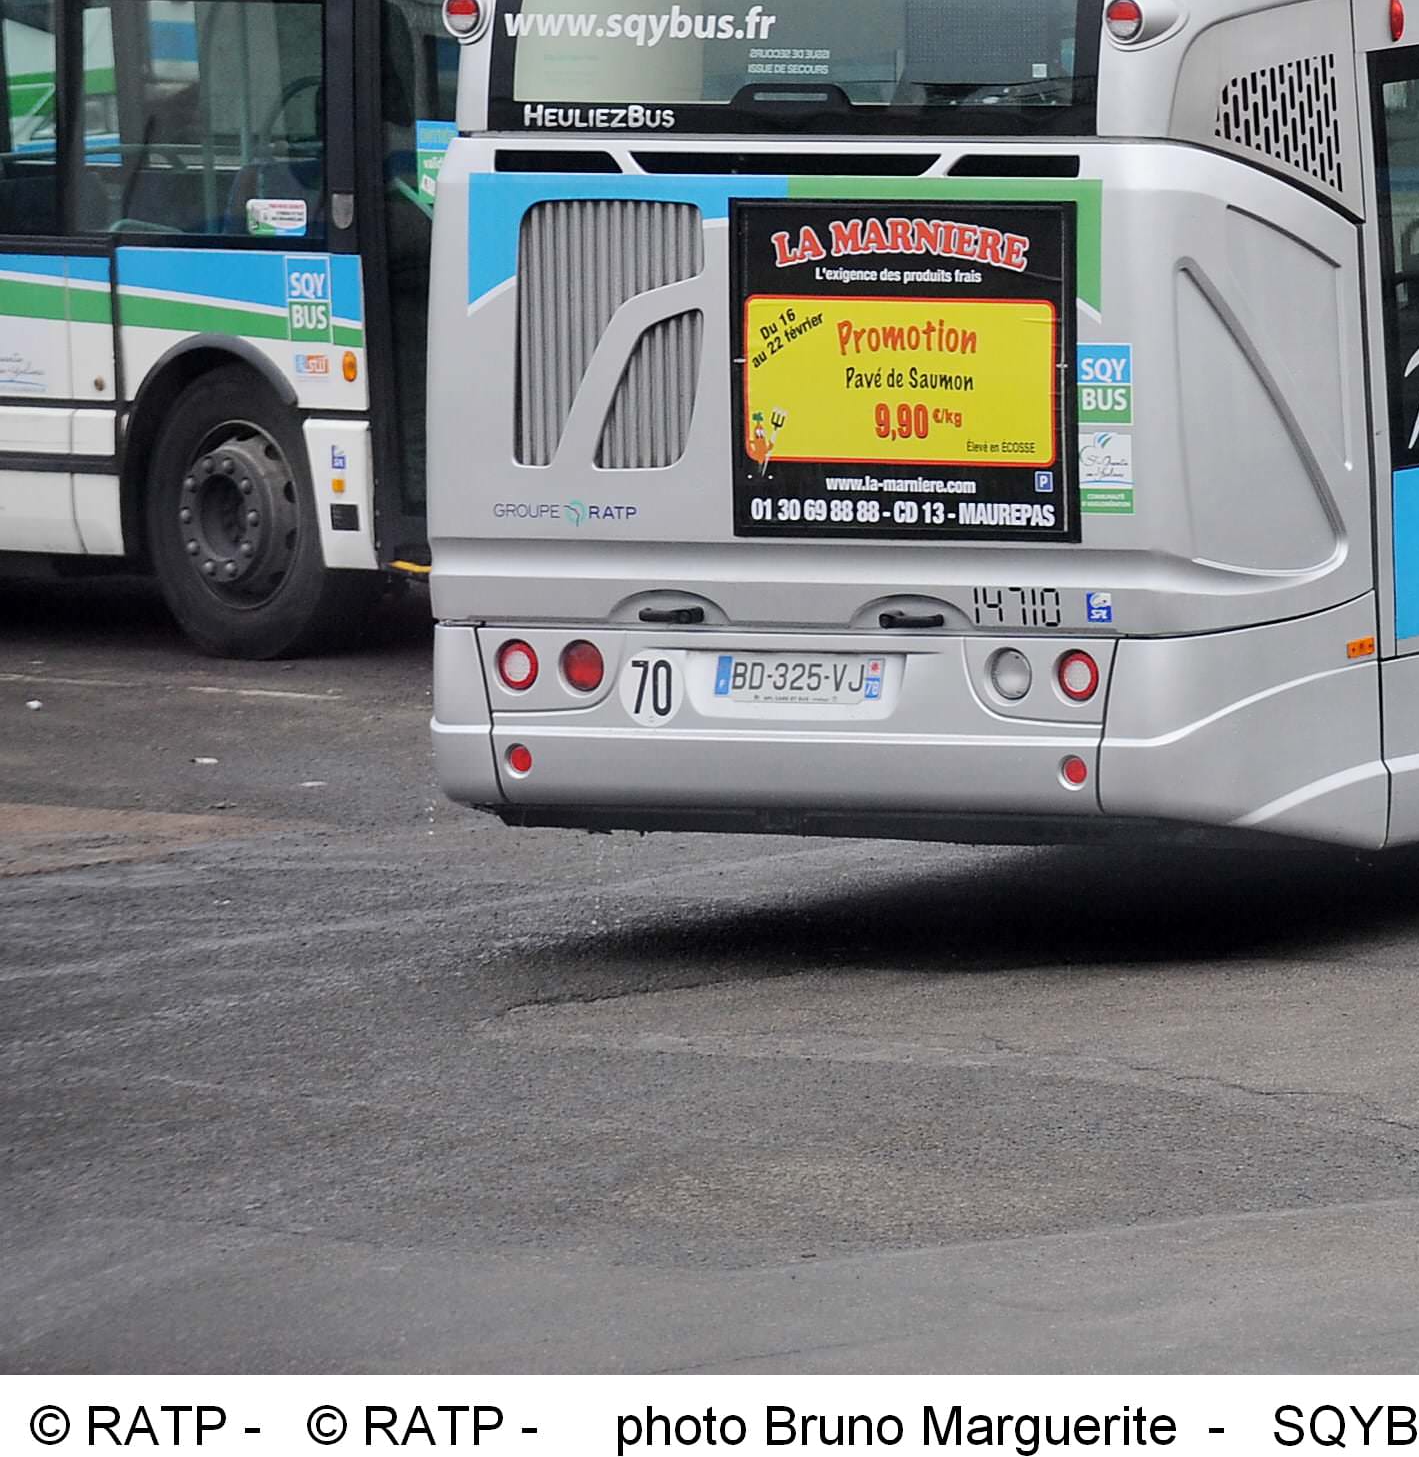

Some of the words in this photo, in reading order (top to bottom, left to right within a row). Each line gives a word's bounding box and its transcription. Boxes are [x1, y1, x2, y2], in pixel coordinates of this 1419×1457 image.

[504, 6, 776, 46] www.sqybus.fr
[748, 64, 773, 74] ISSUE
[774, 64, 787, 74] DE
[787, 64, 829, 75] SECOURS
[771, 225, 825, 268] LA
[828, 217, 1030, 273] MARNIERE
[290, 272, 326, 299] SQY
[815, 267, 878, 284] L'exigence
[879, 268, 901, 282] des
[903, 269, 952, 284] produits
[954, 269, 982, 283] frais
[291, 304, 327, 330] BUS
[760, 325, 778, 341] Du
[779, 309, 796, 328] 16
[752, 352, 768, 369] au
[766, 336, 785, 356] 22
[784, 311, 825, 343] février
[836, 319, 978, 356] Promotion
[845, 367, 882, 390] Pavé
[887, 367, 905, 389] de
[908, 369, 974, 391] Saumon
[1081, 358, 1127, 383] SQY
[1082, 388, 1127, 411] BUS
[874, 403, 930, 441] 9,90
[825, 475, 977, 494] www.la-marniere.com
[493, 503, 561, 519] GROUPE
[588, 506, 637, 520] RATP
[750, 498, 773, 520] 01
[777, 499, 801, 521] 30
[803, 500, 828, 521] 69
[830, 500, 854, 522] 88
[856, 501, 880, 522] 88
[893, 501, 920, 524] CD
[922, 502, 946, 523] 13
[958, 503, 1055, 526] MAUREPAS
[973, 587, 1061, 627] 14710
[631, 658, 672, 716] 70
[731, 661, 864, 692] BD-325-VJ
